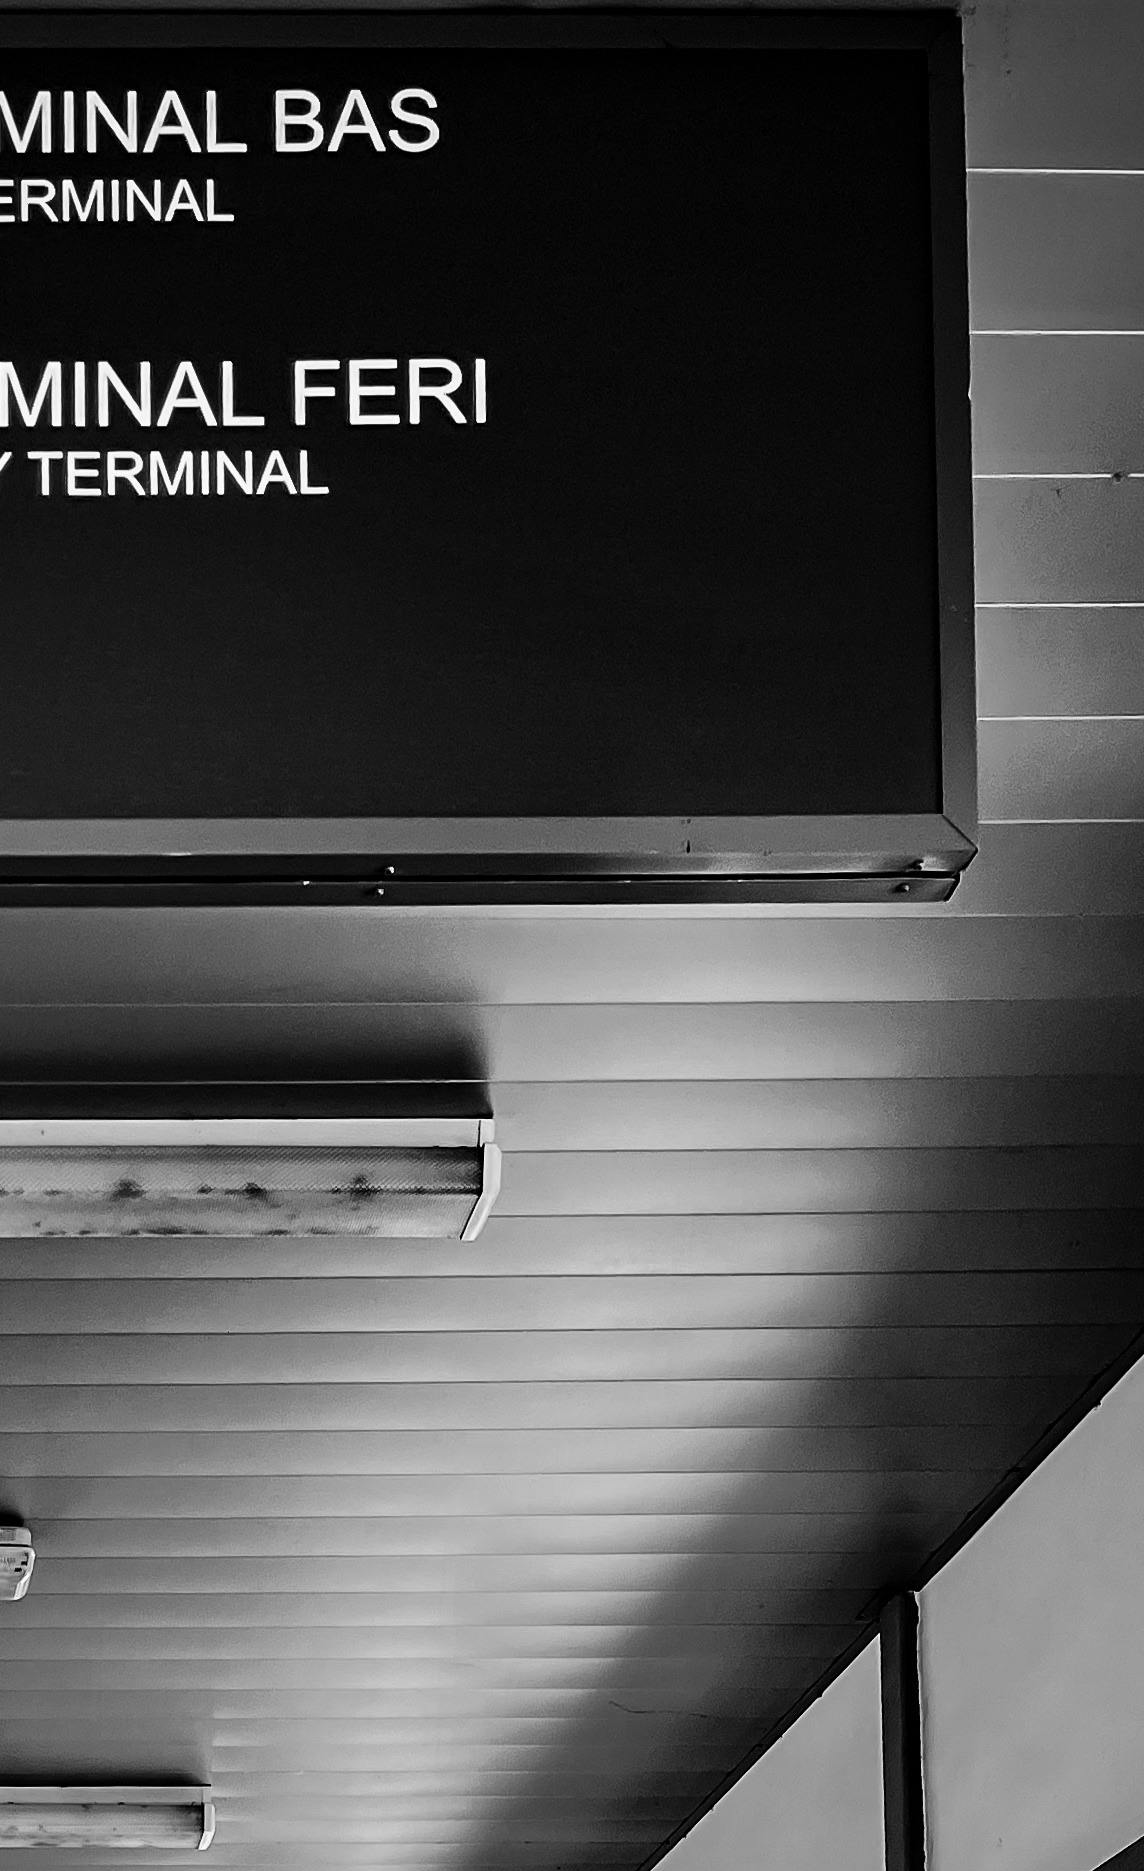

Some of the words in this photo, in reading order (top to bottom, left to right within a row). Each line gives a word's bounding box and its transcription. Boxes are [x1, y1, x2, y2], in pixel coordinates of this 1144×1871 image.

[275, 88, 440, 153] BAS
[294, 358, 487, 426] FERI
[26, 449, 330, 496] TERMINAL
